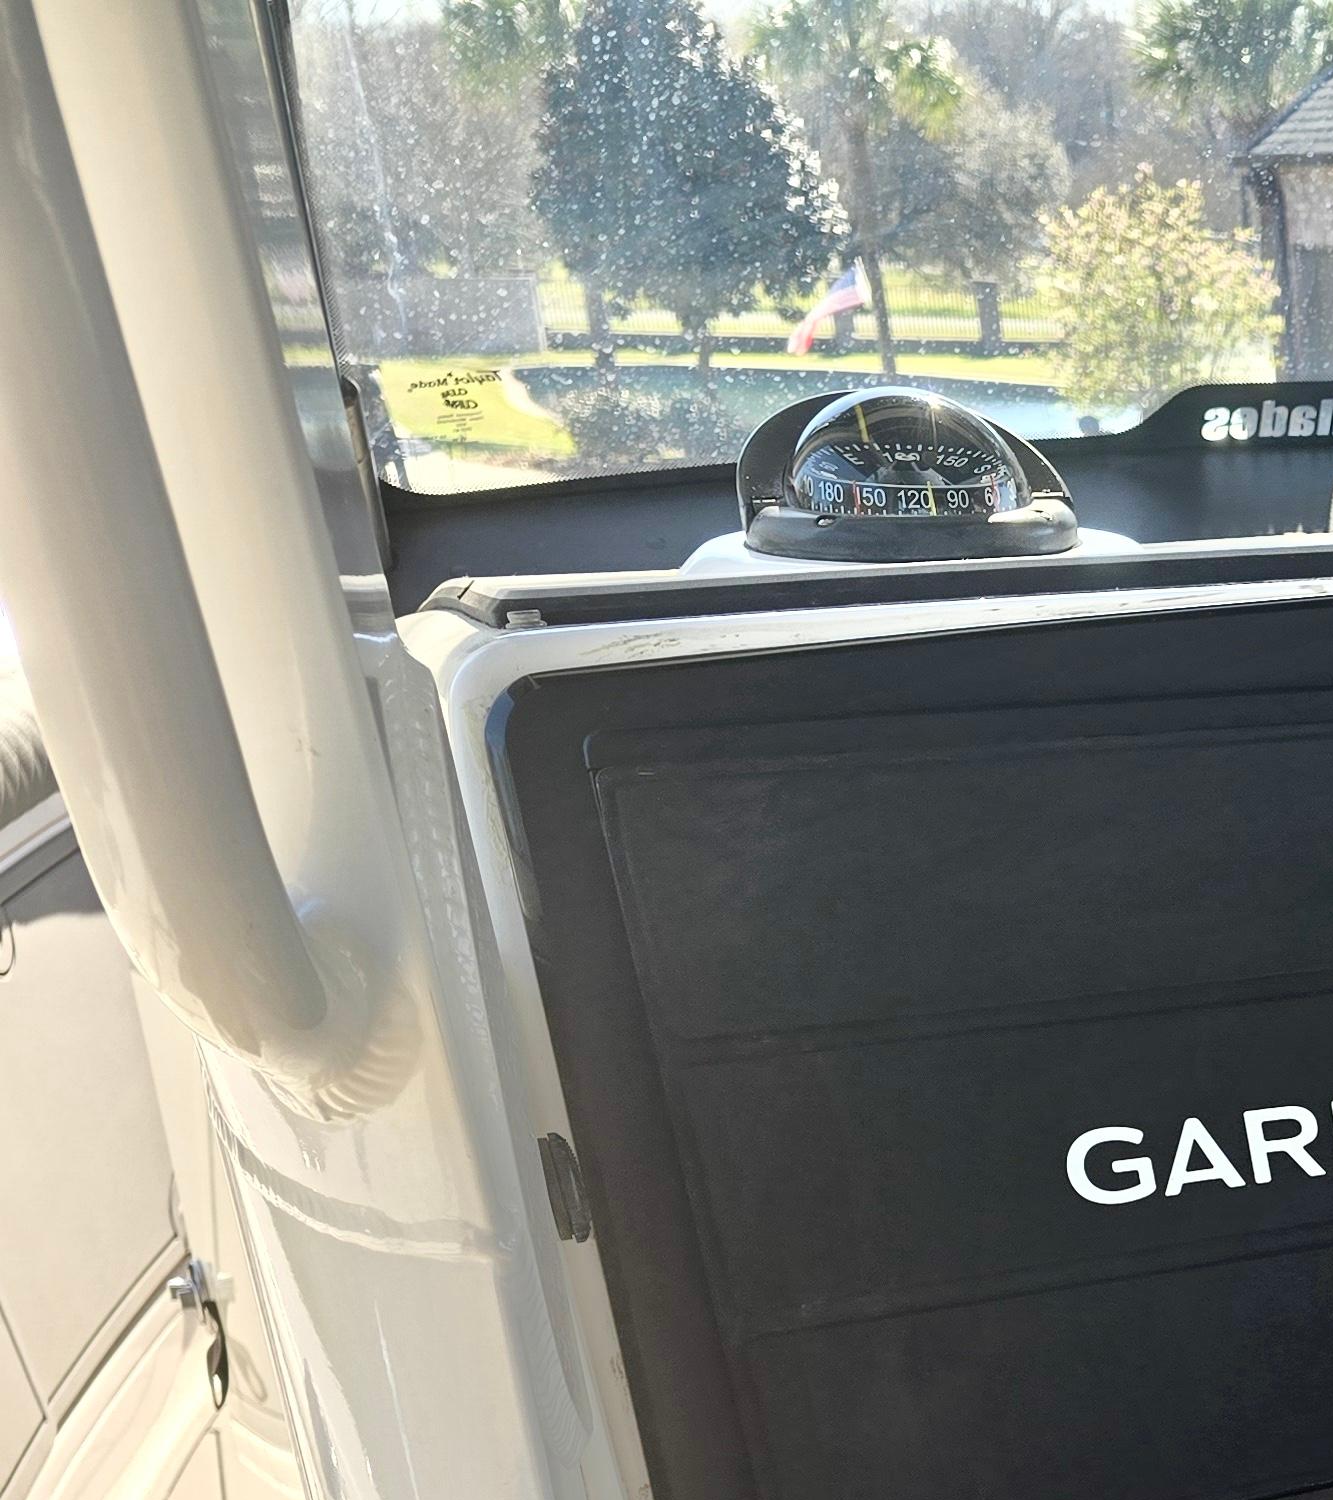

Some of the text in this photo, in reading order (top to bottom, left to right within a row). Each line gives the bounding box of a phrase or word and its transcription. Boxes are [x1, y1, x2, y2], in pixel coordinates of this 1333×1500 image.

[818, 480, 843, 503] 180
[897, 489, 931, 509] 120
[946, 489, 969, 508] 90
